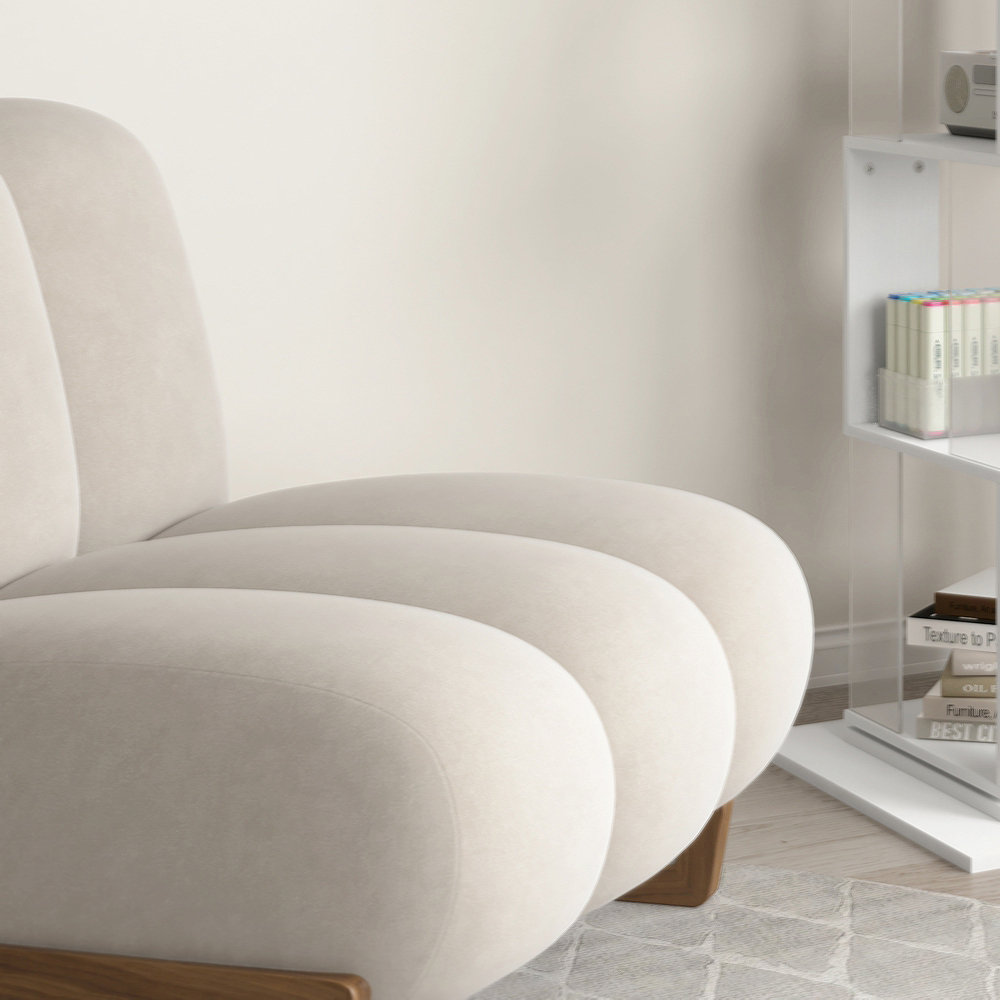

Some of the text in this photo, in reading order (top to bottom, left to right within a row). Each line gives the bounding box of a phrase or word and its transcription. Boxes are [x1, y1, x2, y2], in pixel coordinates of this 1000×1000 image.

[923, 625, 968, 645] Texture
[970, 631, 984, 646] to
[962, 684, 988, 693] OIL
[931, 721, 973, 739] BEST
